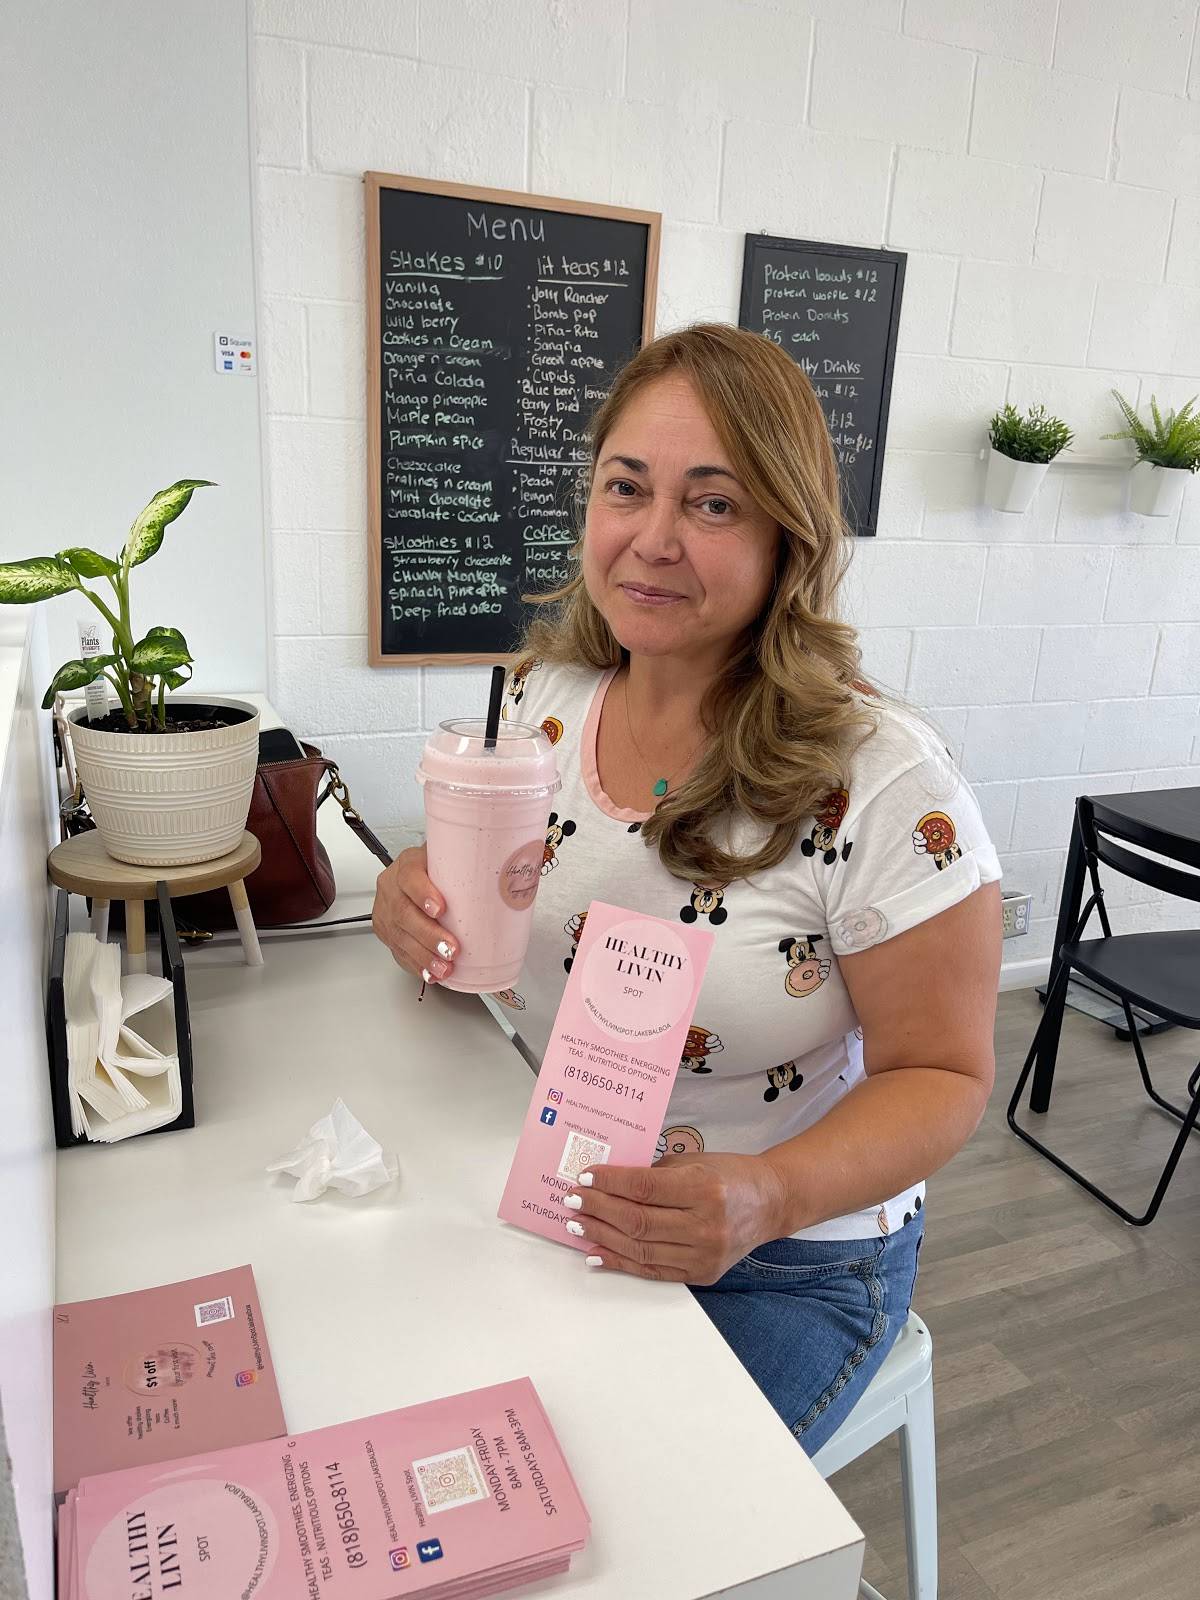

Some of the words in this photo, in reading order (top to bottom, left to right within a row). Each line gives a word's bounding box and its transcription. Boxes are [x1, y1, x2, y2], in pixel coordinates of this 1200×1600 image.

[467, 211, 545, 242] Menu
[475, 254, 503, 271] $10
[561, 255, 599, 277] teas
[603, 258, 629, 276] $12
[765, 264, 810, 284] Protein
[815, 267, 851, 283] bowls
[857, 269, 878, 283] $12
[386, 281, 440, 295] Vanilla
[532, 286, 558, 304] Jolly
[564, 287, 609, 304] Rancher
[813, 290, 848, 300] waffle
[855, 289, 876, 302] $12
[385, 298, 454, 312] Chocolate
[534, 304, 568, 320] Bomb
[573, 309, 597, 323] pop
[386, 315, 414, 329] Wild
[421, 314, 459, 334] berry
[763, 308, 800, 324] Protein
[807, 308, 848, 324] Donuts
[383, 331, 429, 345] Cookies
[434, 336, 443, 345] n
[450, 335, 493, 350] Cream
[763, 328, 782, 345] $5
[792, 330, 820, 342] each
[534, 338, 582, 358] Sangria
[384, 352, 426, 368] Orange
[431, 355, 440, 364] n
[445, 356, 481, 367] cream
[531, 353, 564, 365] Green
[571, 357, 604, 368] apple
[824, 359, 861, 374] Drinks
[435, 371, 485, 388] Colada
[533, 369, 575, 384] Cupids
[522, 379, 550, 395] Blue
[835, 384, 859, 398] $12
[385, 390, 428, 409] Mango
[433, 394, 487, 409] pineapple
[556, 398, 579, 412] bird
[387, 406, 429, 424] Maple
[435, 412, 475, 426] pecan
[523, 413, 563, 430] Frosty
[828, 409, 855, 430] $12
[389, 430, 447, 450] Pumpkin
[529, 428, 557, 440] Pink
[511, 438, 564, 462] Regular
[387, 457, 461, 473] Cheesecake
[540, 465, 557, 476] Hot
[386, 473, 438, 489] Pralines
[444, 478, 453, 488] n
[457, 480, 492, 491] cream
[520, 473, 554, 487] Peach
[390, 489, 420, 504] Mint
[429, 492, 491, 509] Chocolate
[518, 504, 569, 518] Cinnamon
[465, 534, 494, 549] $12
[523, 525, 570, 541] Coffee
[393, 555, 459, 570] Strawberry
[526, 548, 561, 562] House
[447, 570, 497, 583] Monkey
[526, 565, 569, 580] Mocha
[391, 604, 431, 621] Deep
[438, 602, 467, 618] fried
[81, 637, 100, 646] Plants
[605, 936, 687, 970] HEALTHY
[616, 959, 665, 984] LIVIN
[623, 987, 644, 998] SPOT
[561, 1034, 590, 1049] HEALTHY
[631, 1057, 671, 1076] ENERGIZING
[588, 1054, 627, 1073] NUTRITIOUS
[628, 1068, 657, 1083] OPTIONS
[564, 1065, 644, 1102] (818)650-8114
[566, 1099, 646, 1132] HEALTHYLIVINSPOT.LAKEBALBOA
[144, 1361, 156, 1374] off
[146, 1376, 158, 1388] $1
[504, 1408, 531, 1451] 8AM-3PM
[493, 1435, 510, 1458] 7PM
[282, 1454, 299, 1501] ENERGIZING
[299, 1461, 314, 1493] OPTIONS
[403, 1468, 414, 1484] Spot
[470, 1427, 511, 1512] MONDAY-FRIDAY
[505, 1466, 522, 1490] 8AM
[366, 1440, 399, 1542] HEALTHYLIVINSPOT.LAKEBALBOA
[408, 1484, 419, 1502] LIVIN
[523, 1452, 558, 1516] SATURDAYS
[306, 1493, 326, 1554] NUTRITIOUS
[325, 1461, 368, 1569] (818)650-8114
[413, 1502, 426, 1528] Healthy
[127, 1511, 152, 1600] EALTHY
[157, 1523, 182, 1591] LIVIN
[197, 1535, 210, 1561] SPOT
